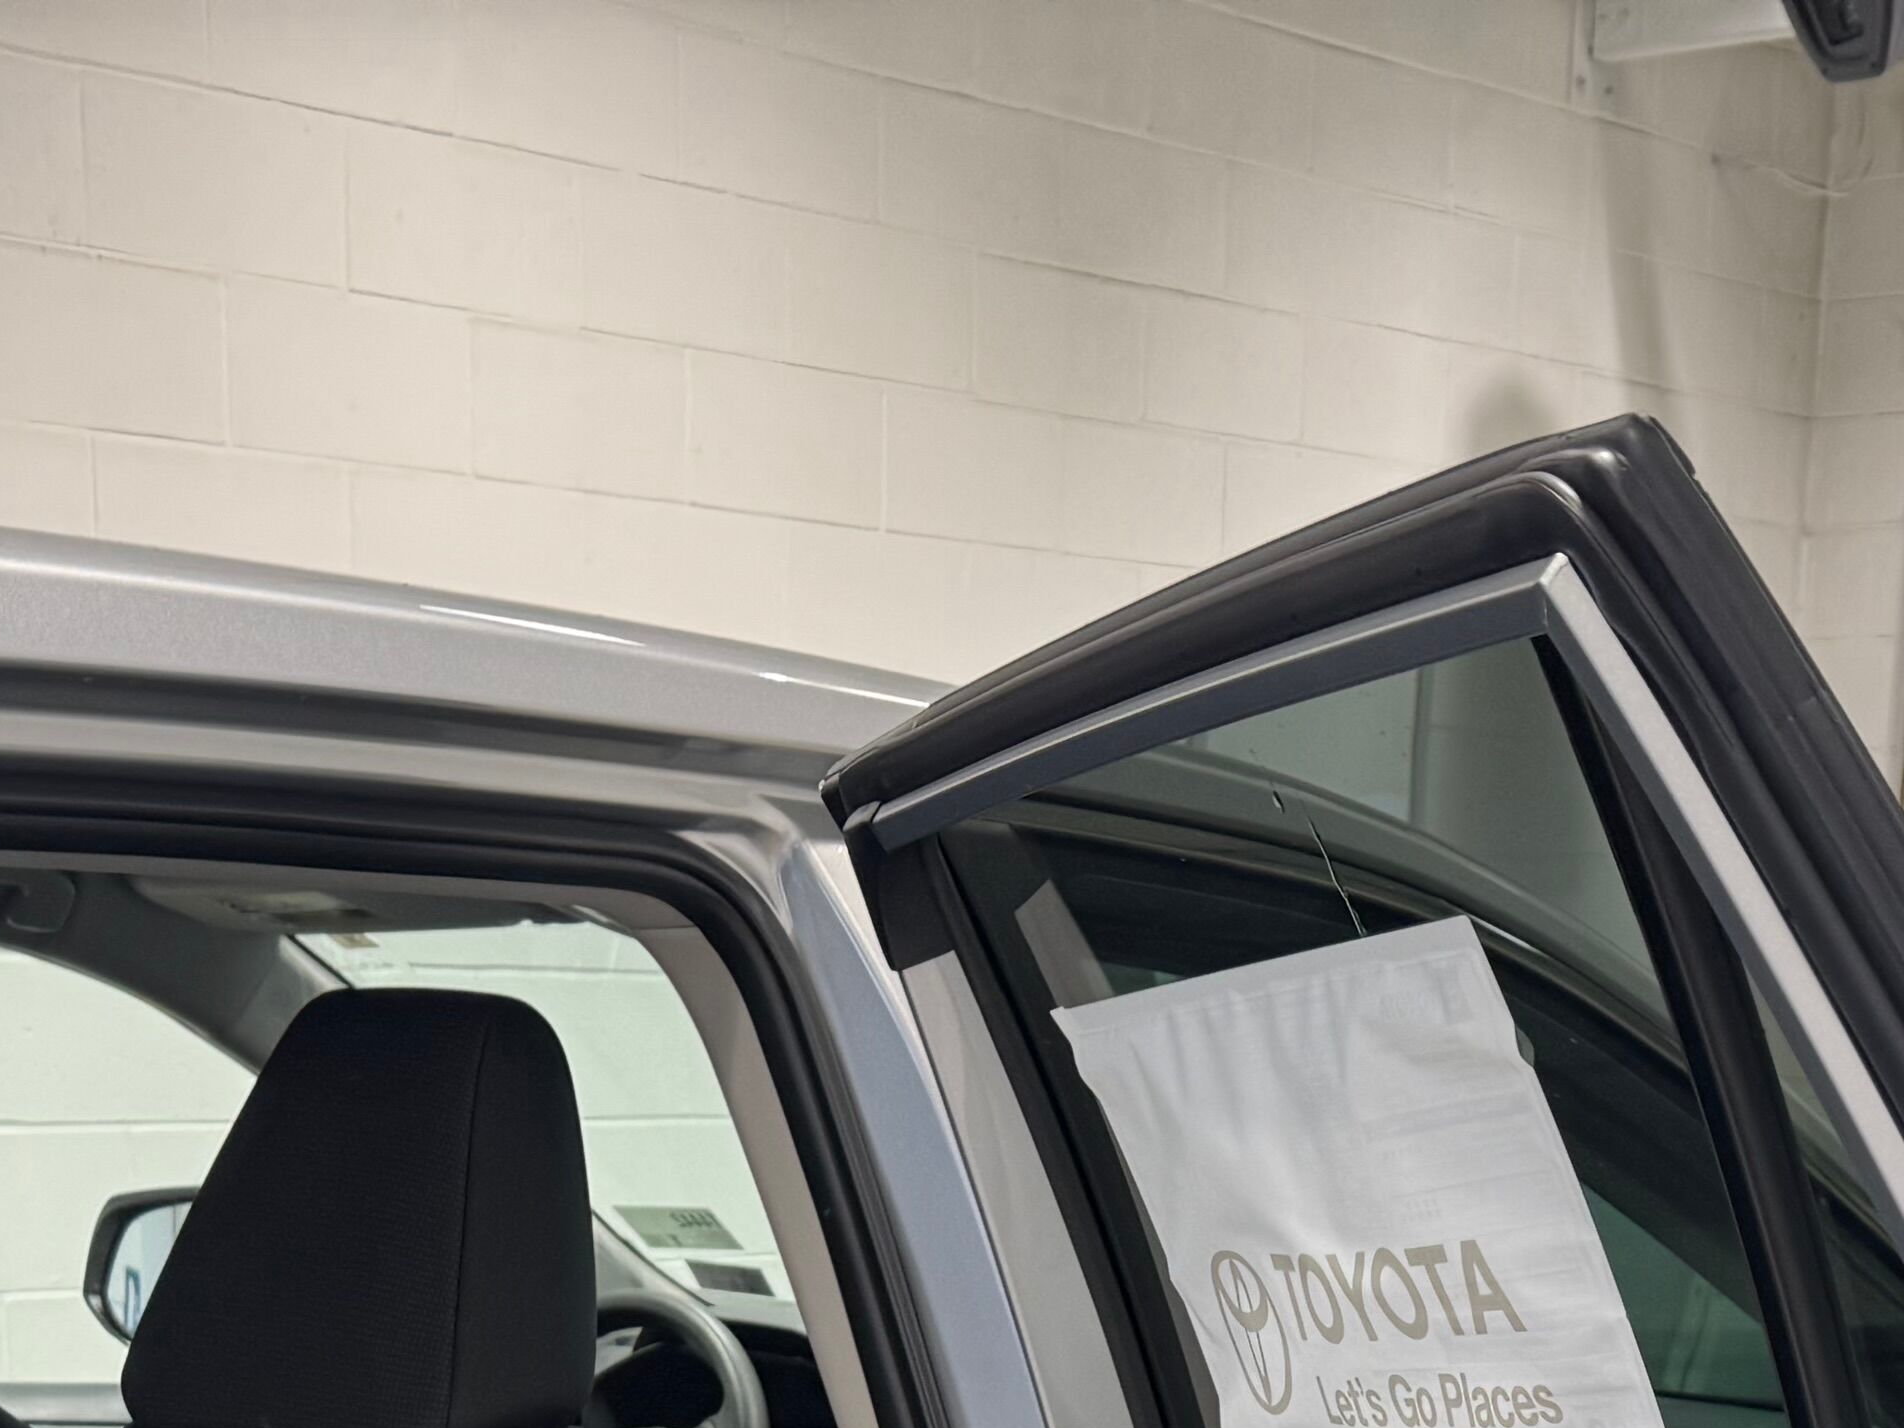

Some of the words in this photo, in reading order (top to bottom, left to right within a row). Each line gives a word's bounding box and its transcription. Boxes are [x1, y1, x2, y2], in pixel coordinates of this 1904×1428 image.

[1270, 1239, 1528, 1345] TOYOTA
[1316, 1375, 1388, 1427] Let's
[1388, 1373, 1438, 1428] Go
[1438, 1372, 1563, 1428] Places
